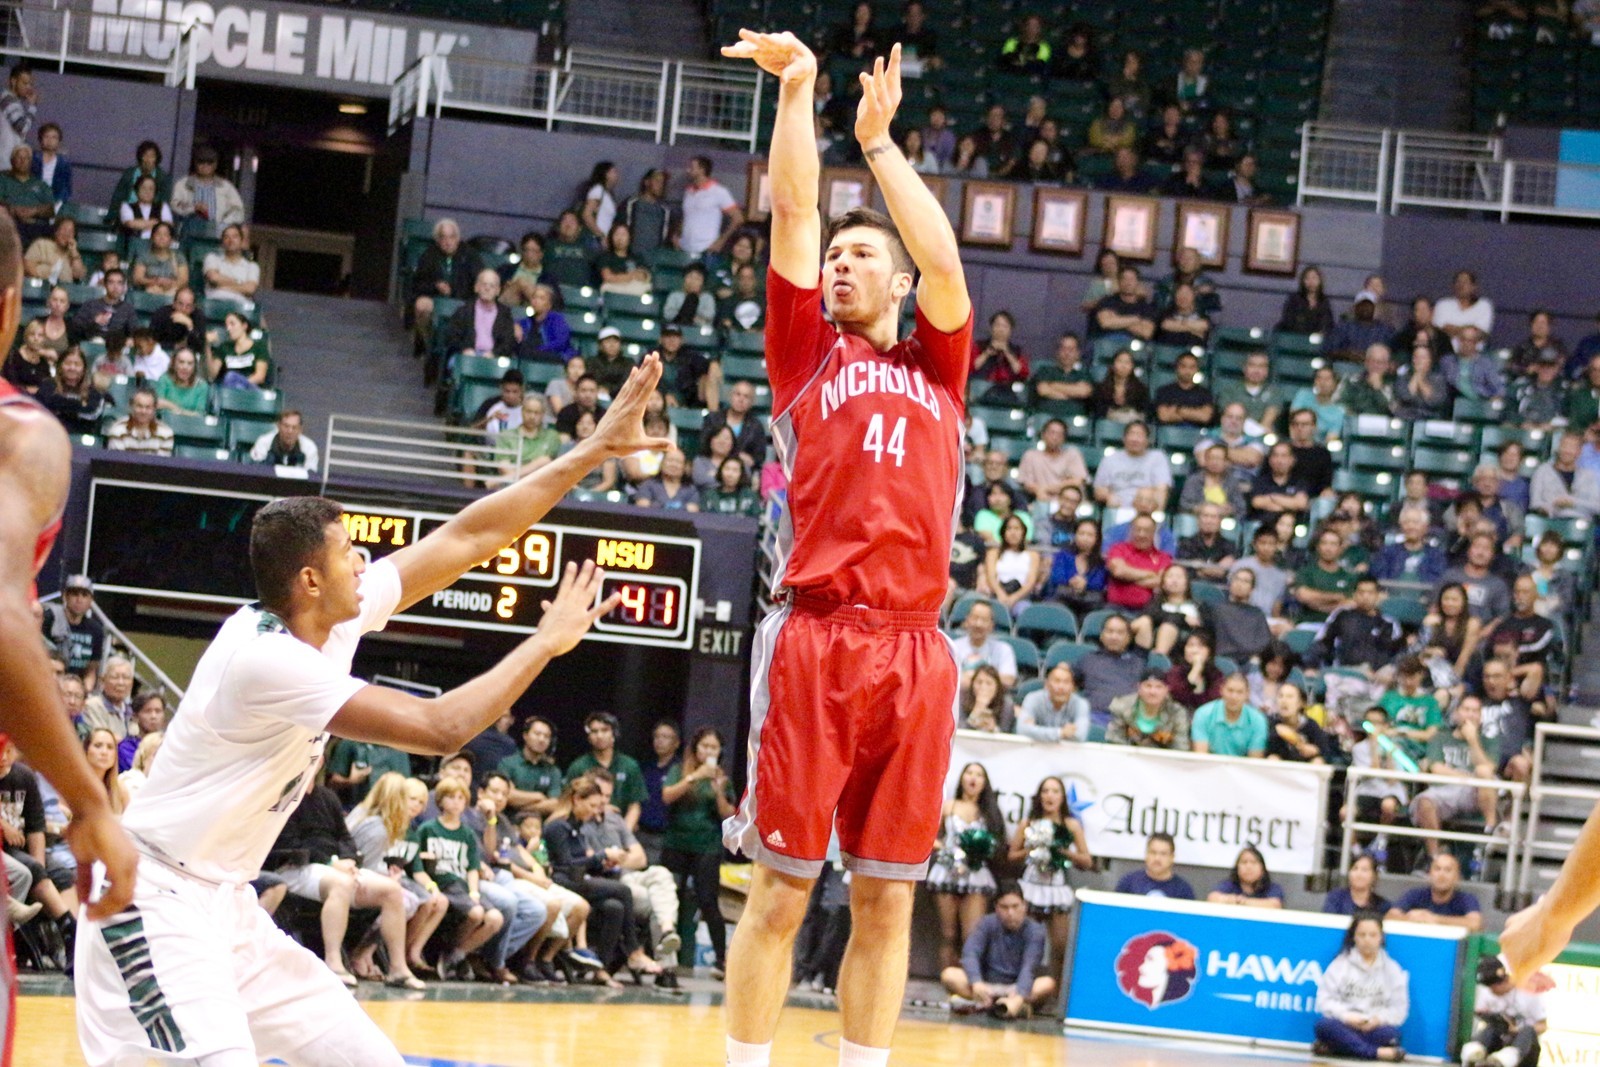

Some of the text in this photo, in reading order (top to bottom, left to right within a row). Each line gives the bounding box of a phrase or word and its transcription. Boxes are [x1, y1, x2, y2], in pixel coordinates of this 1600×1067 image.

[88, 0, 309, 75] MUSCLE
[862, 413, 907, 467] 44
[596, 539, 655, 570] NSU
[433, 585, 518, 619] PERIOD 2
[621, 584, 674, 625] 41
[699, 627, 743, 656] EXIT
[1101, 793, 1301, 850] Advertiser
[1206, 949, 1323, 986] HAWA
